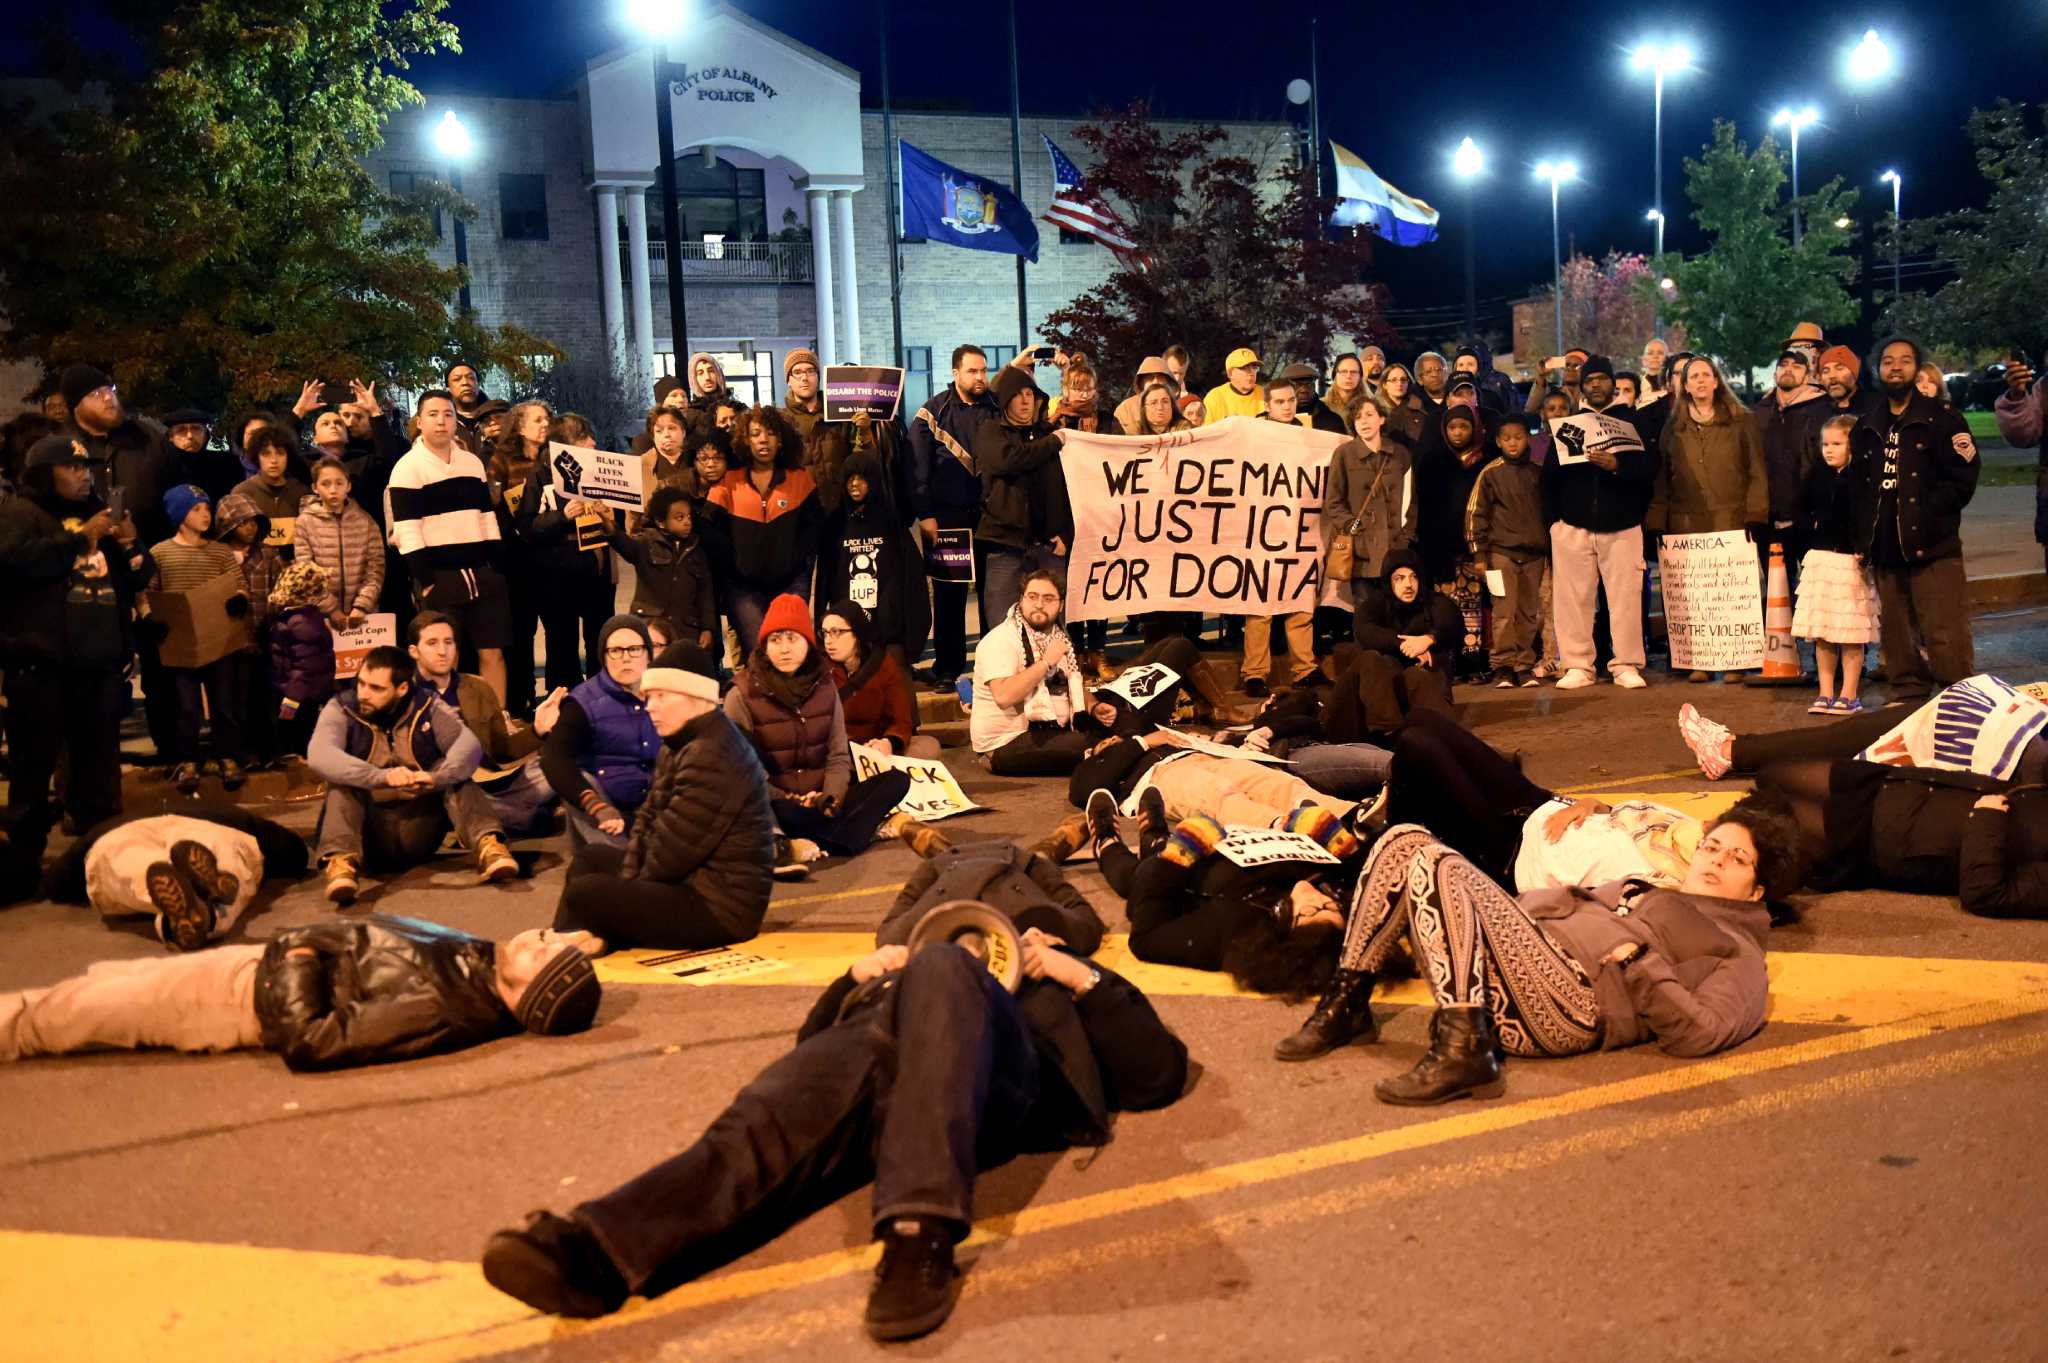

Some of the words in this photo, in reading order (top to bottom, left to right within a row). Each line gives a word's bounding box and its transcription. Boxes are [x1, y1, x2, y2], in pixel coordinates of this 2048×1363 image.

[673, 71, 700, 96] CITY
[702, 66, 721, 80] OF
[722, 68, 778, 100] ALBANY
[697, 89, 755, 102] POLICE
[827, 387, 855, 396] DISARM
[874, 389, 899, 398] POLICE
[595, 456, 624, 467] BLACK
[598, 468, 623, 477] LIVES
[1102, 458, 1152, 497] WE
[593, 476, 630, 488] MATTER
[1101, 499, 1323, 552] JUSTICE
[1083, 558, 1150, 605] FOR
[852, 588, 875, 600] 1UP
[338, 627, 364, 637] Good
[365, 627, 388, 636] Cops
[1668, 623, 1687, 635] STOP
[1687, 624, 1706, 637] THE
[1708, 622, 1761, 637] VIOLENCE
[354, 638, 364, 646] in
[859, 754, 946, 784] BLCK
